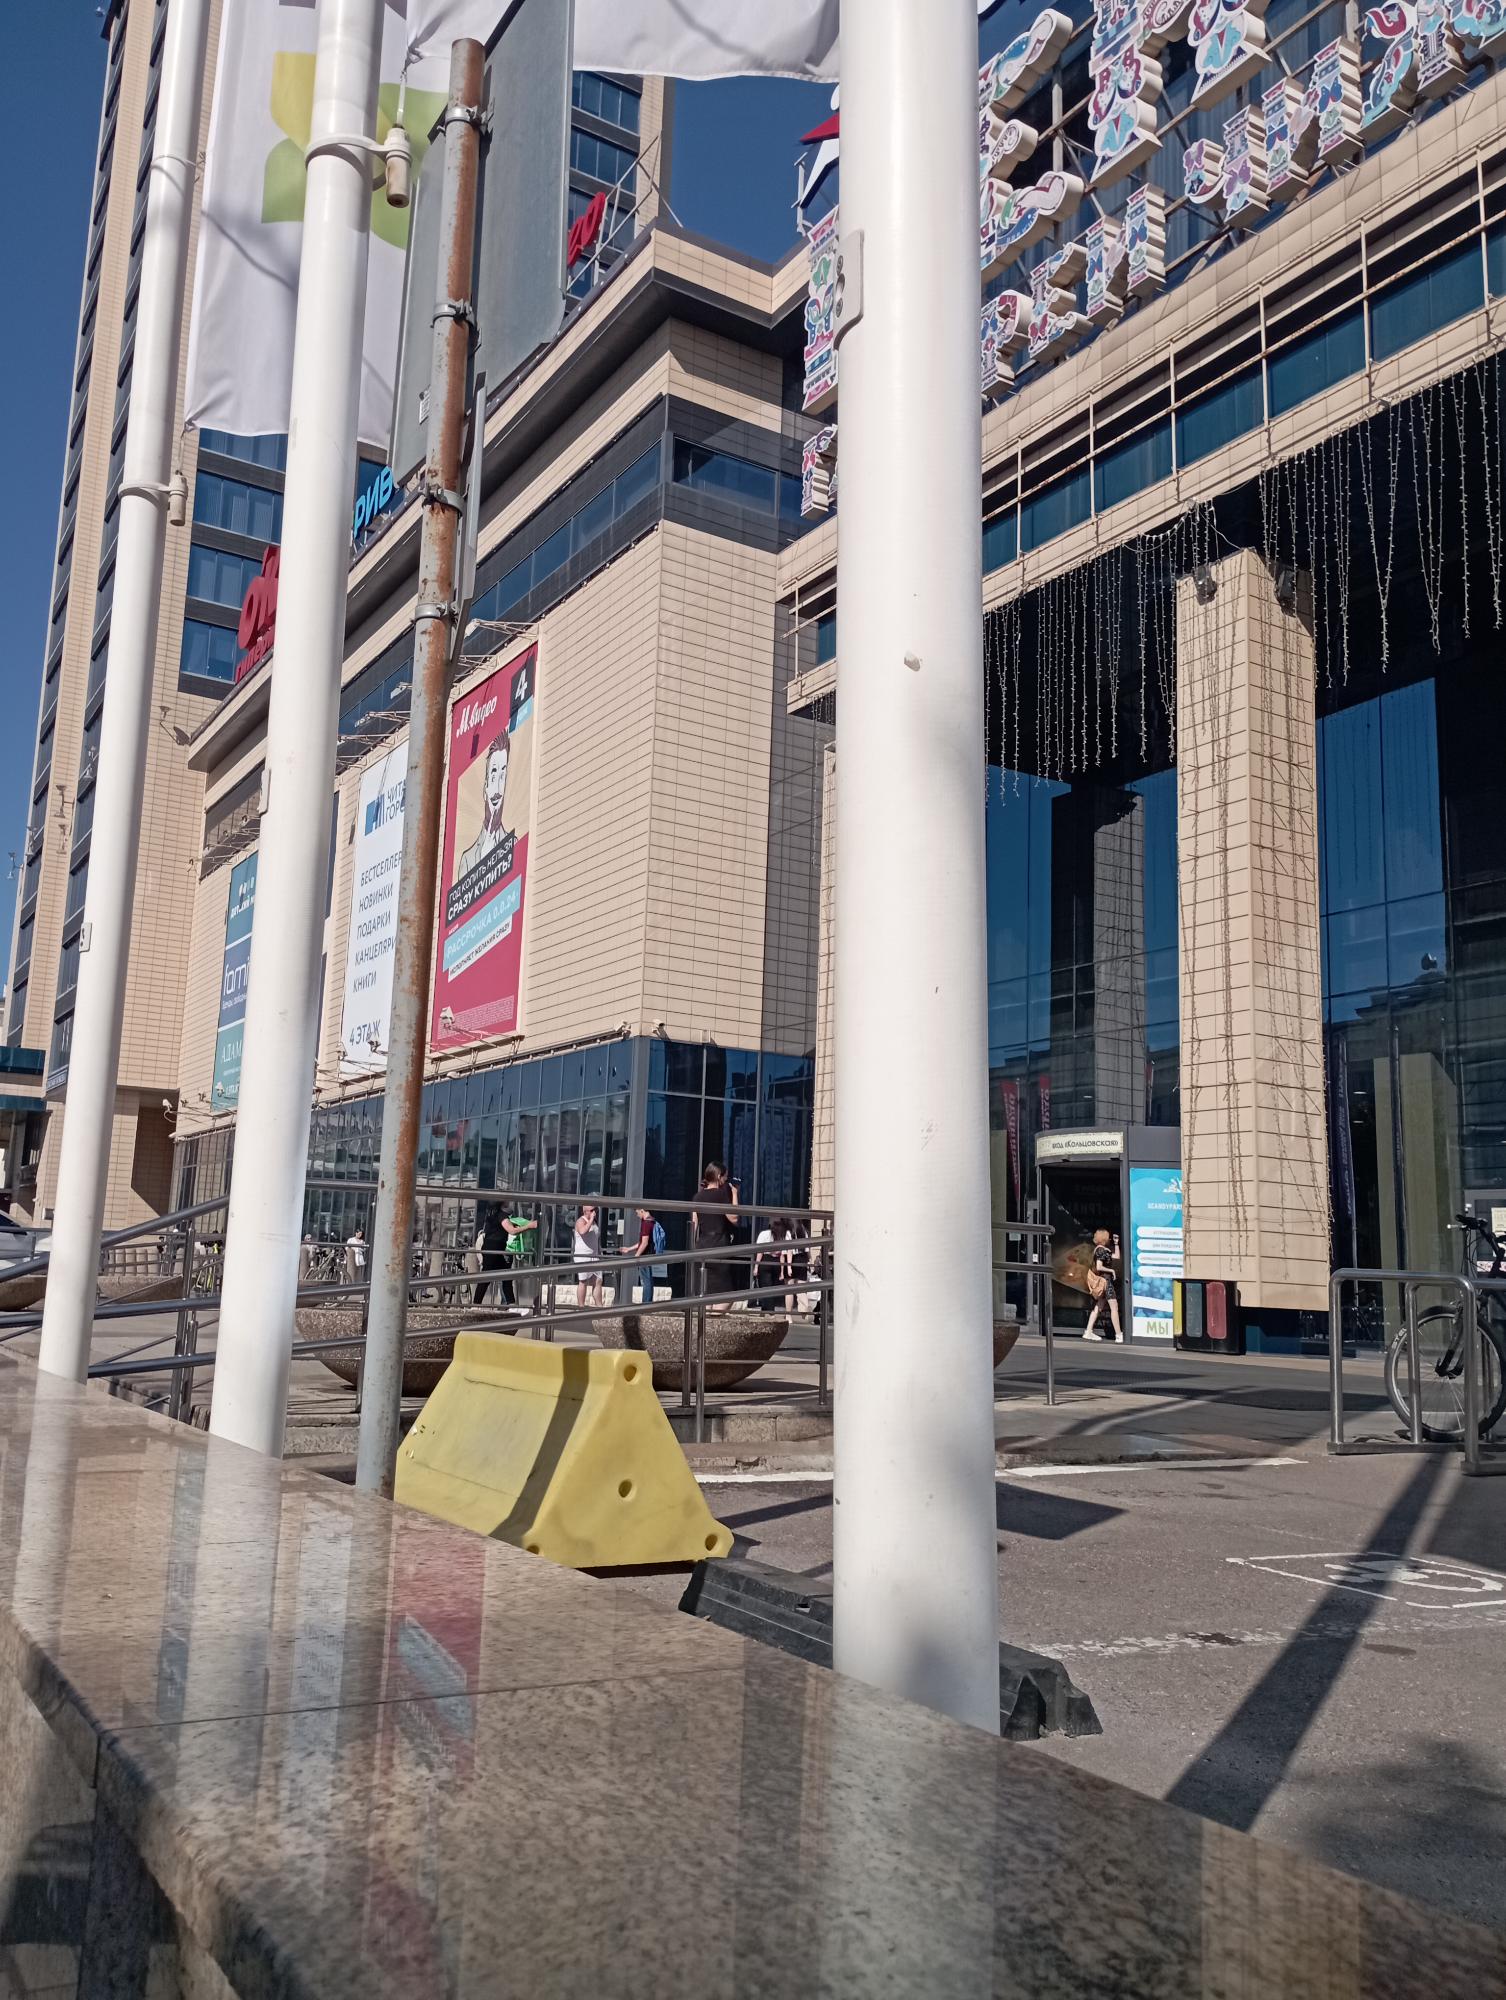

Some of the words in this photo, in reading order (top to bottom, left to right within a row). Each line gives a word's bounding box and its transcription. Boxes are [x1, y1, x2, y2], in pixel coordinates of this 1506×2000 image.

[514, 668, 528, 701] 4
[447, 890, 475, 920] СРАЗУ
[474, 853, 512, 899] КУПИТЬ?
[449, 885, 462, 904] ГОД
[461, 865, 487, 893] КОПИТЬ
[487, 838, 513, 868] НЕЛЬЗЯ
[359, 882, 393, 912] НОВИНКИ
[356, 910, 391, 940] ПОДАРКИ
[446, 912, 492, 958] РАССРОЧКА
[353, 970, 377, 993] КНИГИ
[1146, 1321, 1169, 1336] МЫ
